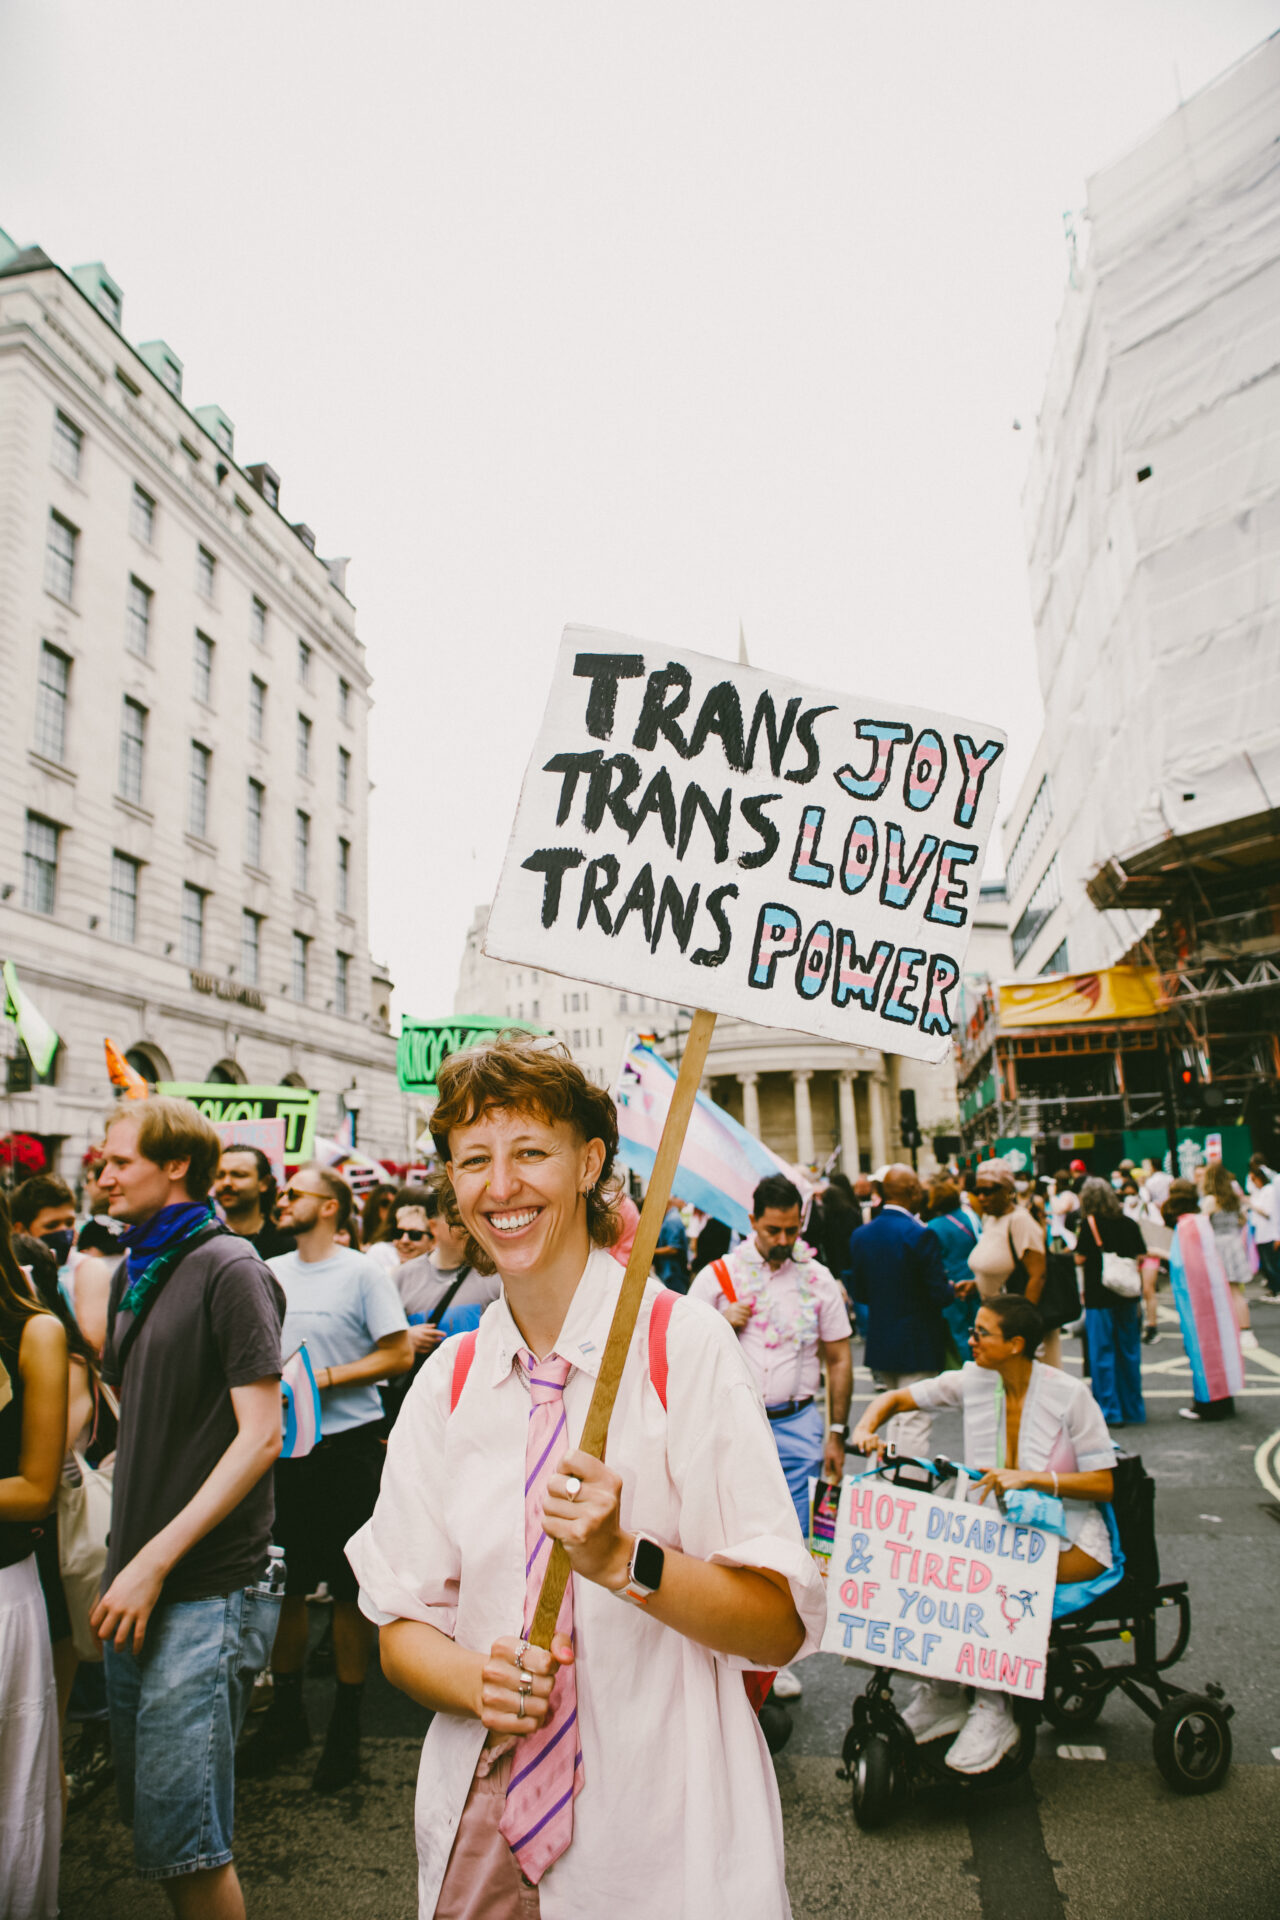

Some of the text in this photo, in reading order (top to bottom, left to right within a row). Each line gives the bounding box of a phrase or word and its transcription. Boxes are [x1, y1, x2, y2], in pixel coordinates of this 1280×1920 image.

[572, 652, 1004, 828] TRANS JOY
[541, 749, 978, 927] TRANS LOVE
[520, 847, 960, 1036] TRANS POWER
[845, 1532, 992, 1594] & TIRED
[849, 1488, 1047, 1564] HOT, DISABLED
[839, 1579, 990, 1639] OF YOUR
[838, 1613, 1043, 1690] TERF AUNT
